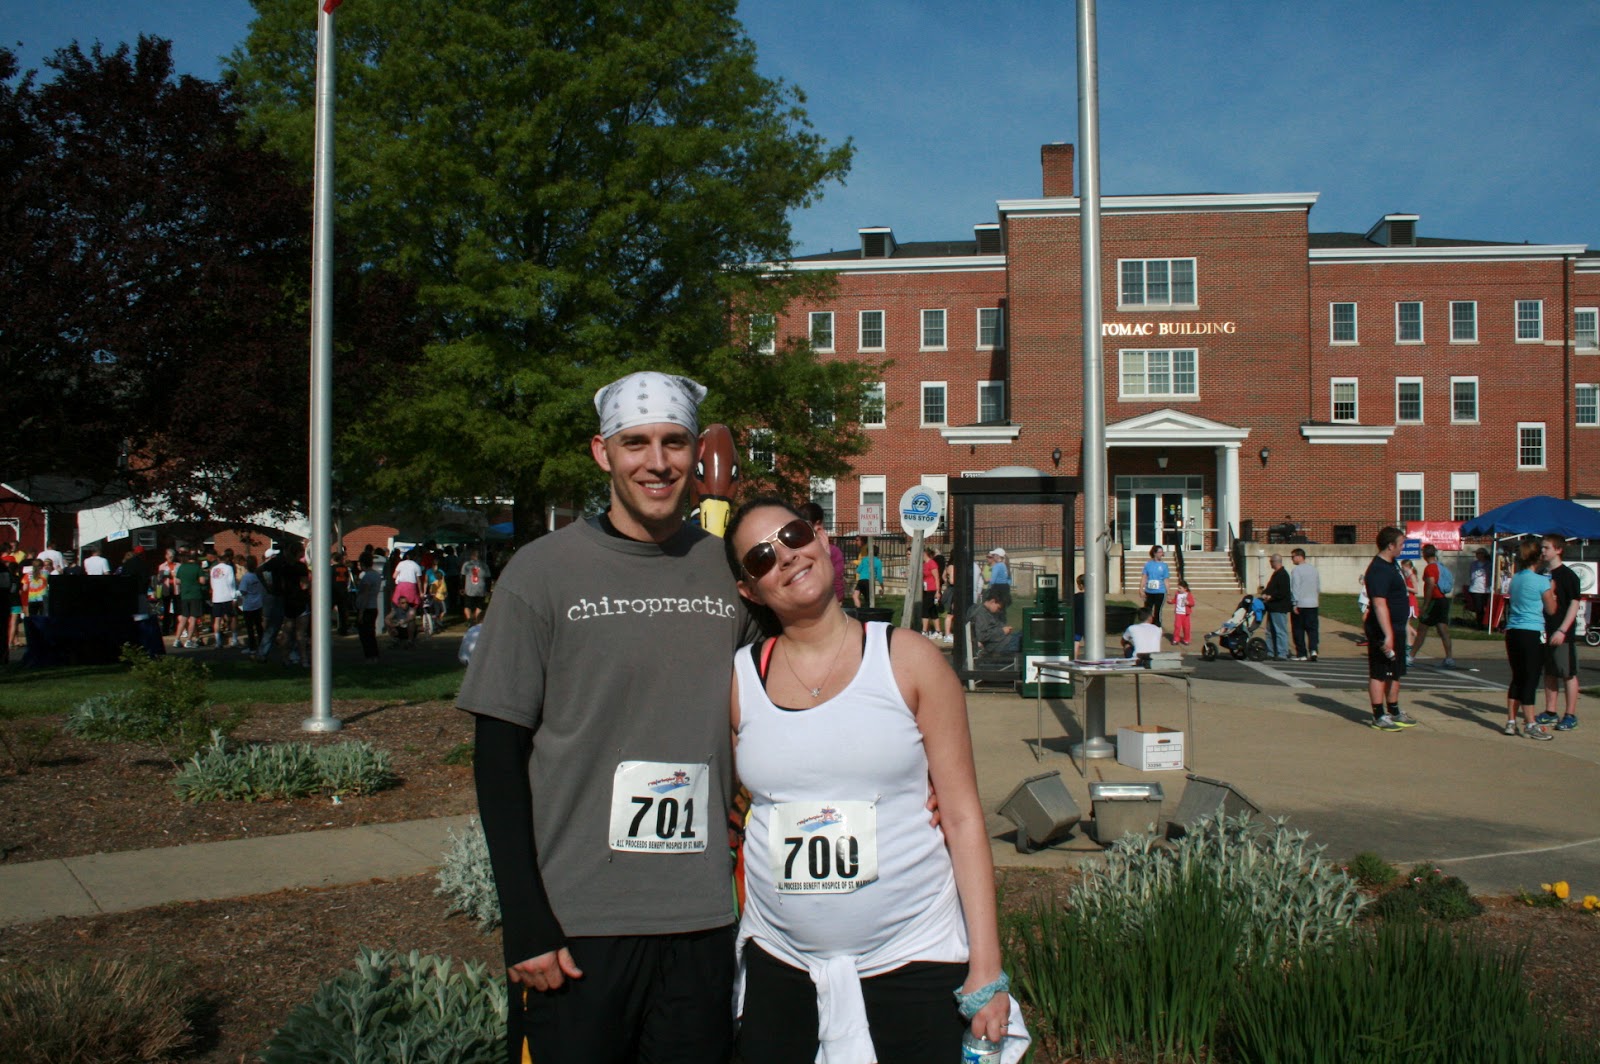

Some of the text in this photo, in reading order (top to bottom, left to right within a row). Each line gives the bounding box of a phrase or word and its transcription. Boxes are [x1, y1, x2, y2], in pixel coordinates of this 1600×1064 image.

[1101, 321, 1237, 336] TOMAC BUILDING
[567, 595, 736, 621] chiropractic
[628, 796, 696, 839] 701
[616, 840, 625, 848] ALL
[625, 840, 648, 849] PROCEEDS
[648, 841, 666, 850] BENEFIT
[666, 841, 683, 850] HOSPICE
[784, 835, 859, 880] 700
[784, 881, 803, 890] PROCEEDS
[803, 881, 821, 890] BENEFIT
[821, 881, 840, 890] HOSPICE
[841, 881, 847, 889] OF
